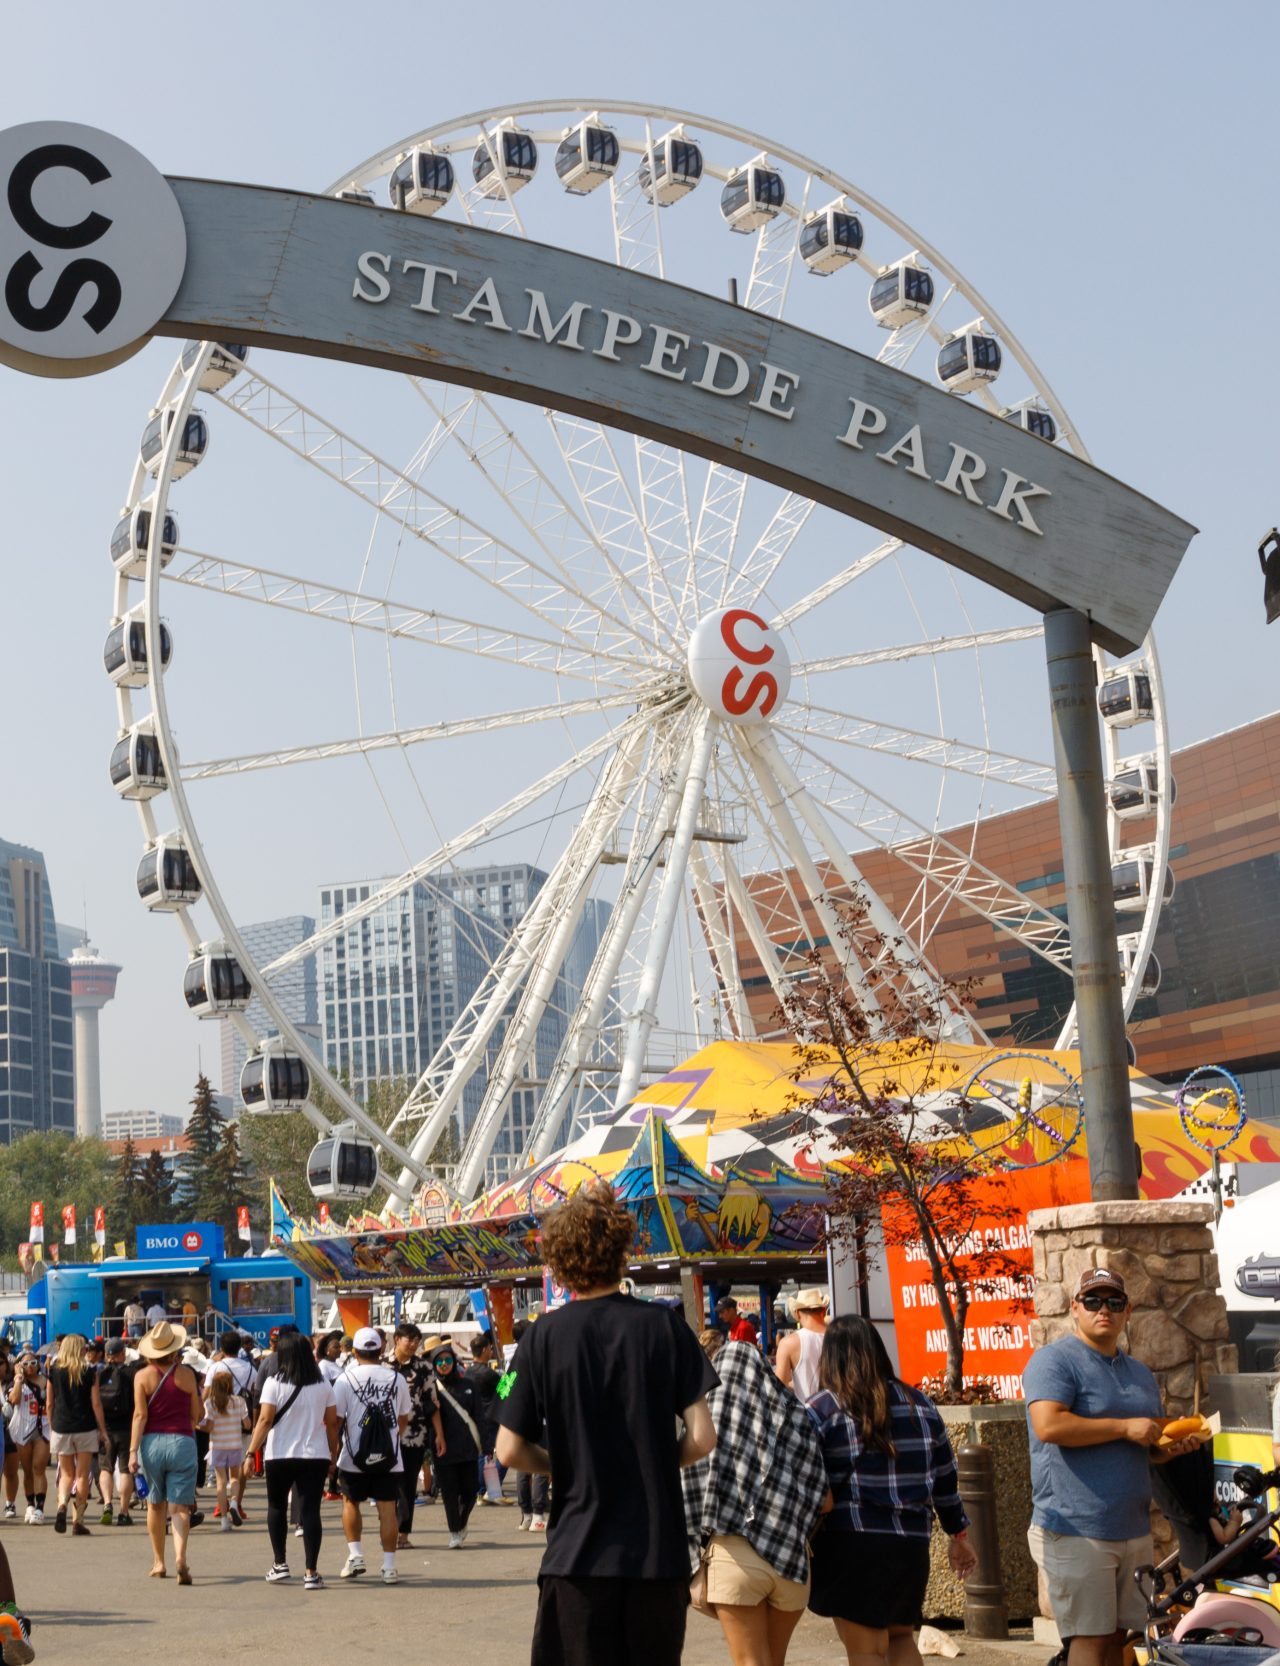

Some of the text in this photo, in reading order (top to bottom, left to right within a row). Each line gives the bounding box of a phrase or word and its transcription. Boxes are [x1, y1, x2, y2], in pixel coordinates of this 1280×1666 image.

[352, 251, 1052, 536] STAMPEDE PARK
[146, 1236, 179, 1249] BMO
[902, 1285, 917, 1309] BY
[926, 1328, 949, 1352] AND
